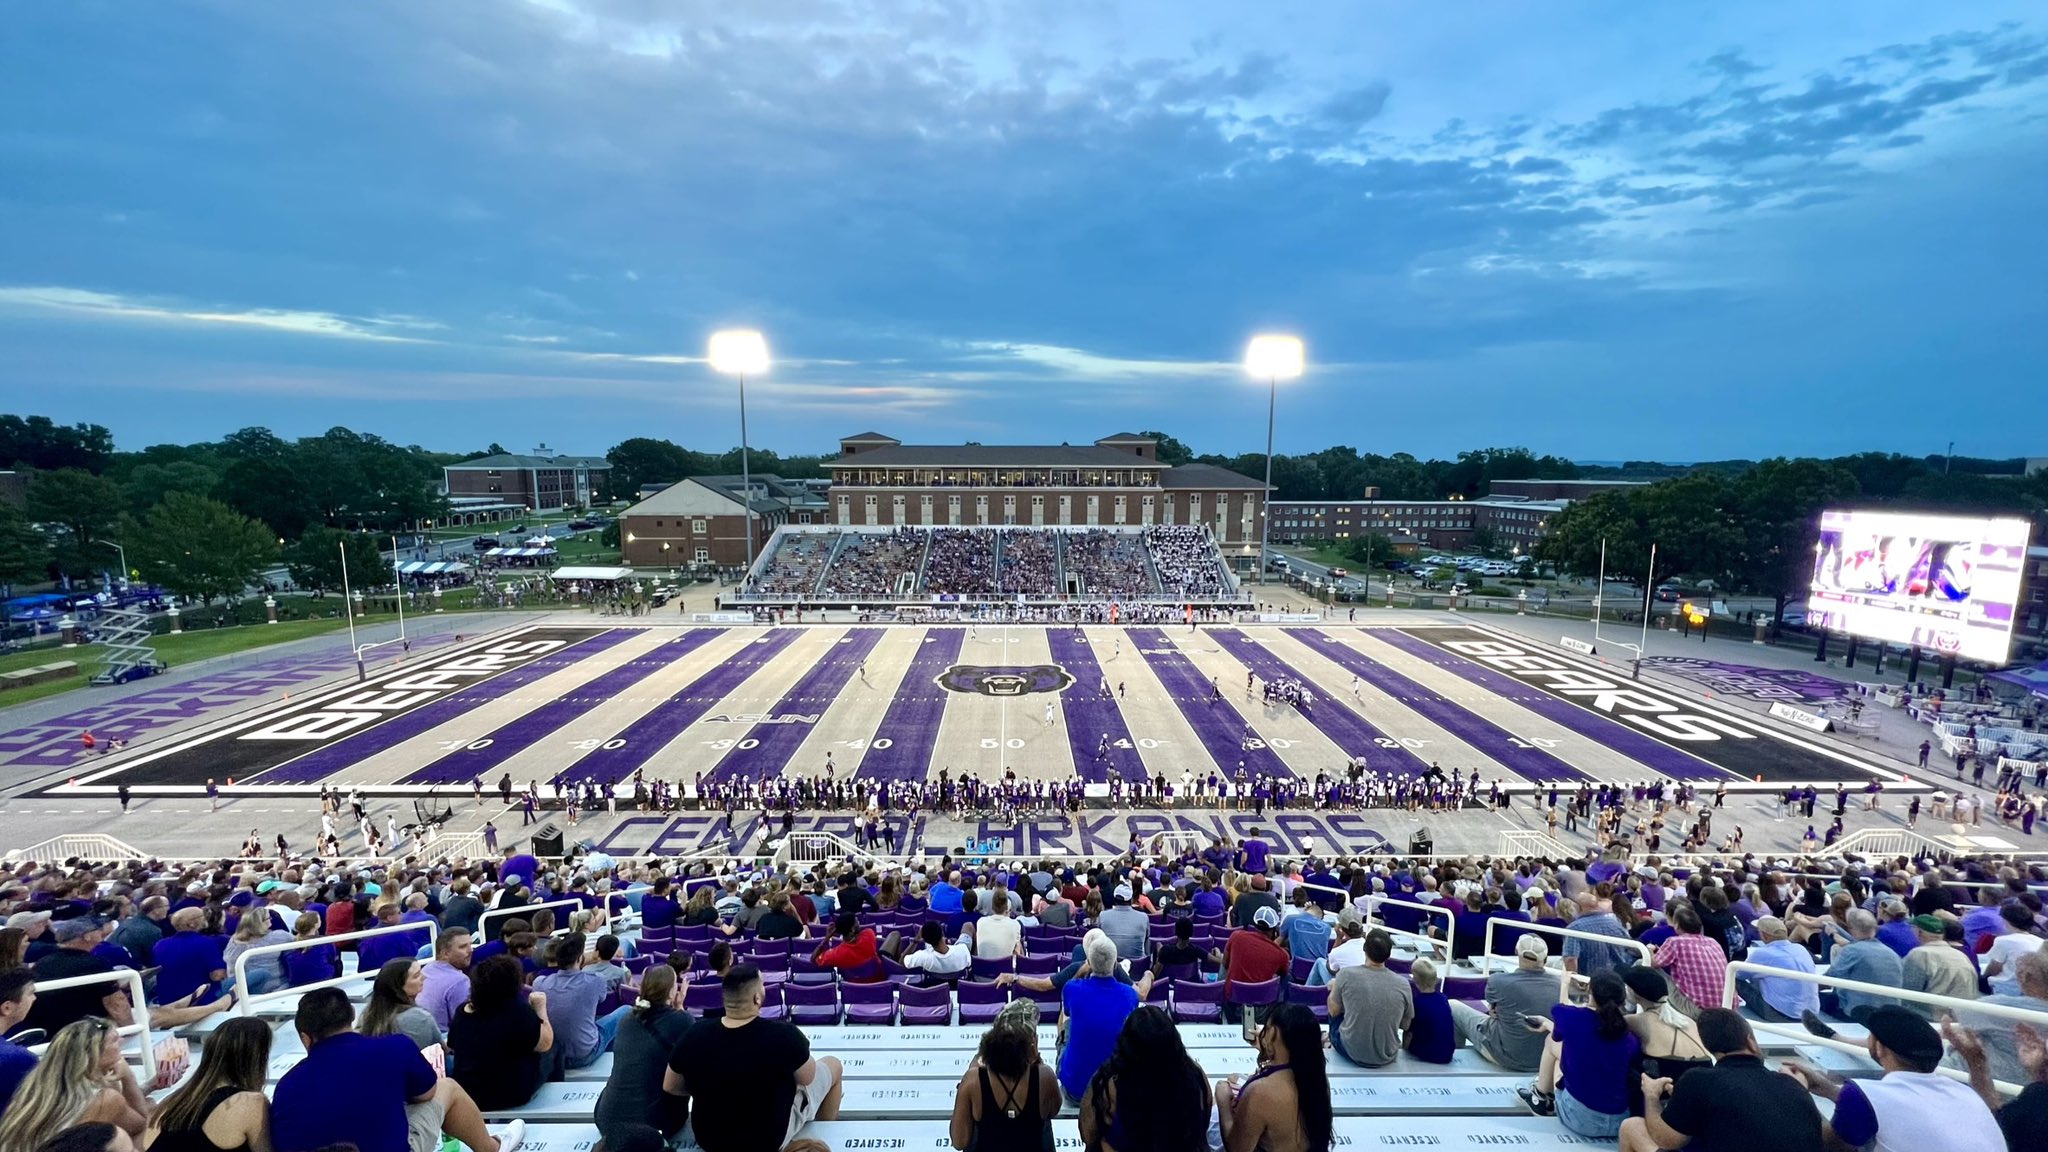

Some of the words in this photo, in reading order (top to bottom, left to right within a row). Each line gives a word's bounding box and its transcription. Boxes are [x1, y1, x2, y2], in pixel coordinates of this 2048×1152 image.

[236, 639, 567, 740] BEARS
[1441, 641, 1757, 741] BEARS
[701, 713, 820, 724] ASUN
[440, 738, 494, 750] 10
[574, 738, 627, 750] 20
[711, 738, 760, 750] 30
[847, 738, 893, 749] 40
[980, 738, 1025, 749] 50
[1113, 738, 1159, 749] 40
[1374, 737, 1424, 749] 20
[1507, 737, 1556, 748] 10
[976, 814, 1395, 856] ARKANSAS
[1330, 1087, 1377, 1096] RESERVE
[1475, 1086, 1516, 1096] SERVED
[845, 1138, 905, 1149] RESERVED
